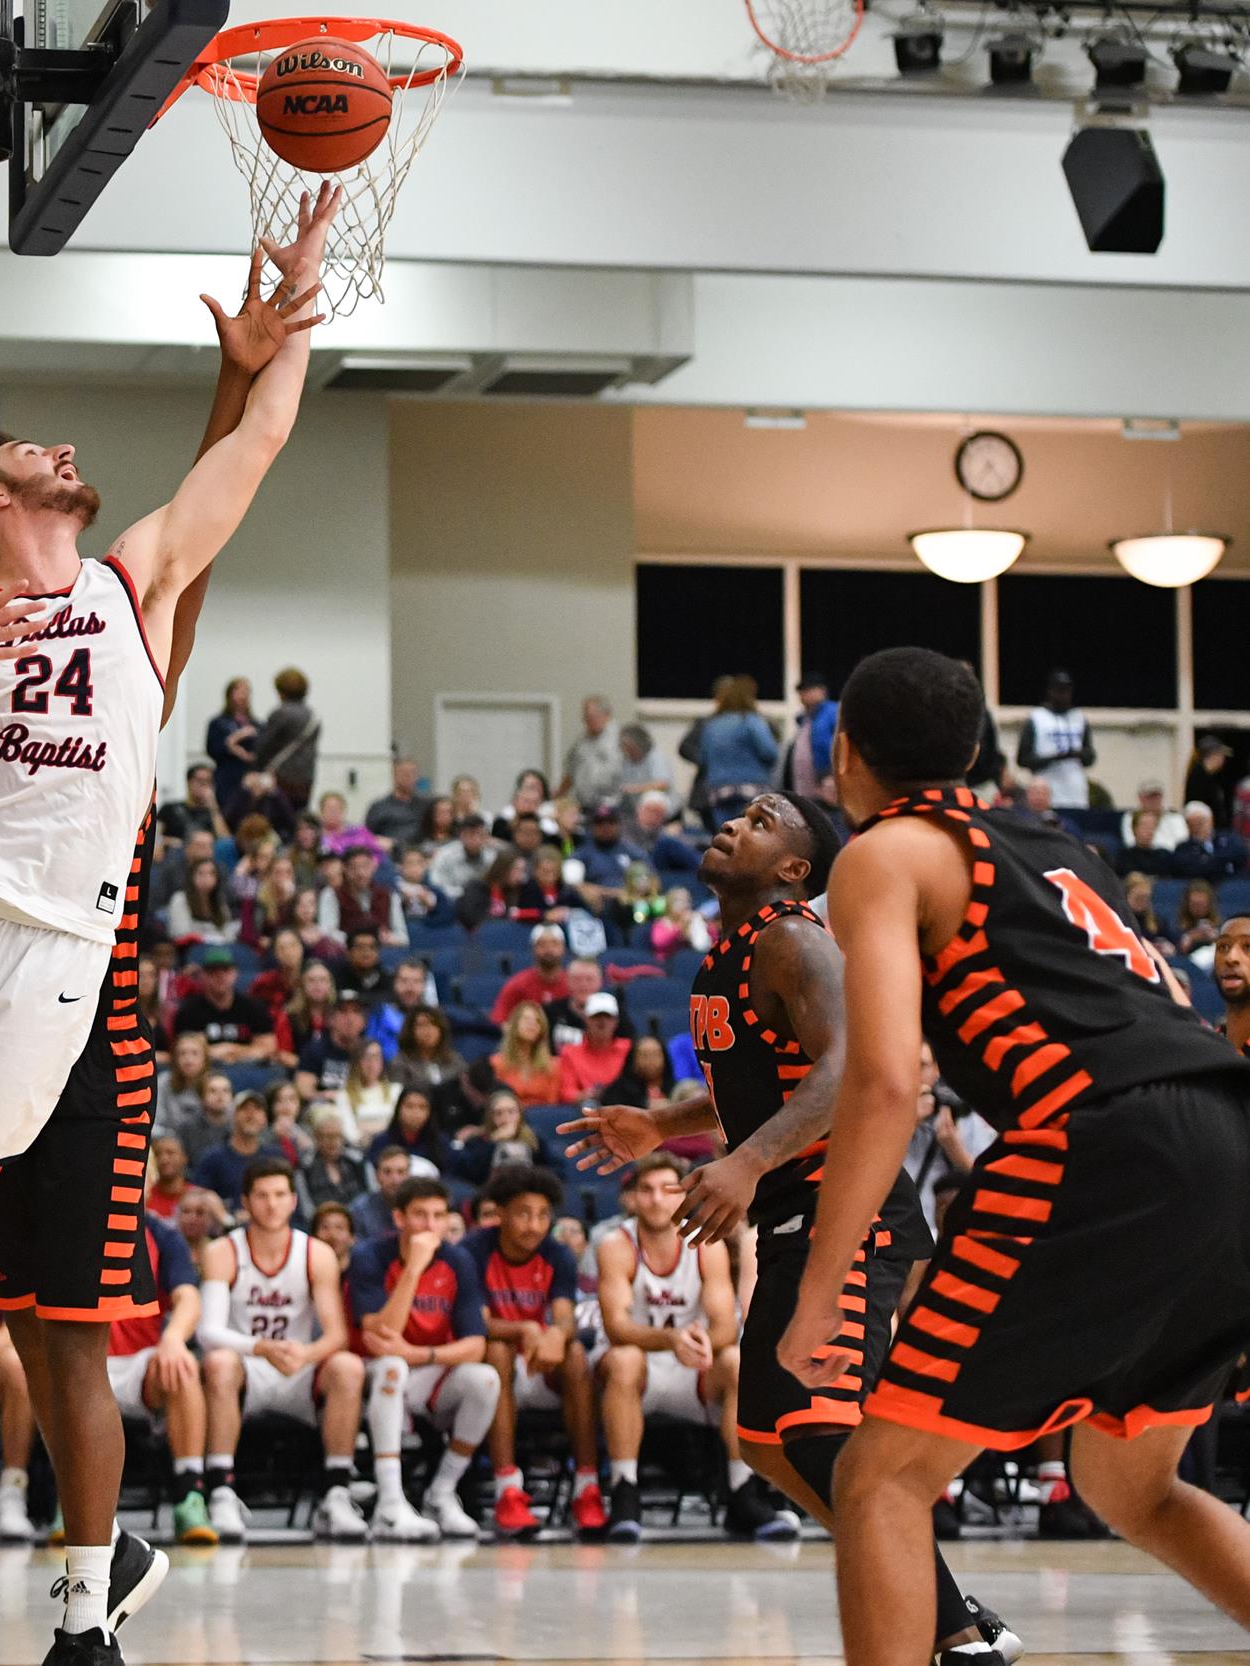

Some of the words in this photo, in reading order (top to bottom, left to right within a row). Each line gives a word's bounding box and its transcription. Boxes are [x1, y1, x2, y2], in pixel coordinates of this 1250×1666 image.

[276, 51, 364, 79] Wilson
[283, 94, 348, 115] NCAA
[11, 647, 94, 717] 24
[1042, 867, 1161, 984] 4
